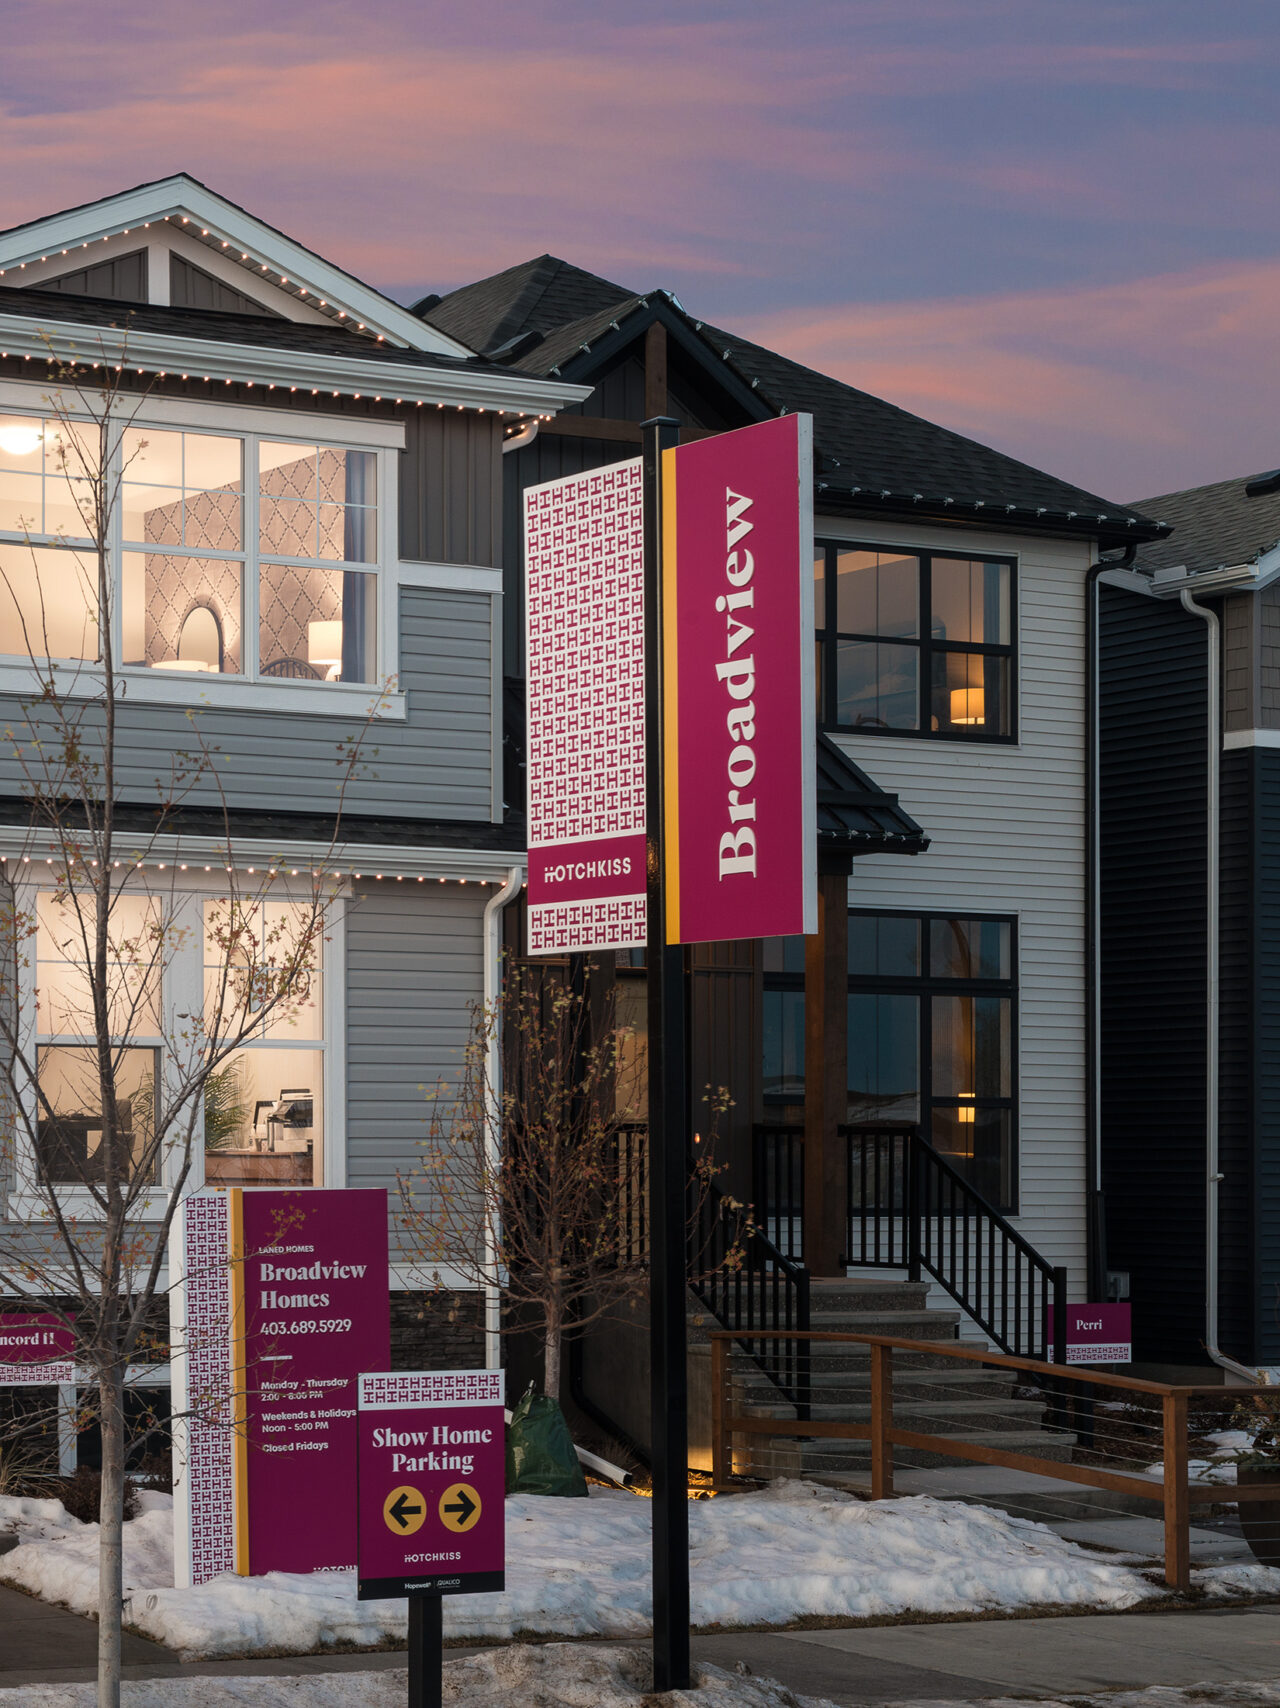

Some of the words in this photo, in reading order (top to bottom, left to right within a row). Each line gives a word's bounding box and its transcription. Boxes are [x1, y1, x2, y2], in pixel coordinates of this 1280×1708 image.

[714, 486, 757, 882] Broadview
[544, 857, 631, 883] HOTCHKISS
[260, 1260, 368, 1282] Broadview
[260, 1290, 330, 1309] Homes
[261, 1319, 352, 1335] 403.689.5929
[1076, 1319, 1103, 1330] Perri
[261, 1381, 299, 1390] Monday
[307, 1378, 348, 1388] Thursday
[261, 1411, 309, 1421] Weekends
[310, 1410, 317, 1419] &
[318, 1409, 357, 1418] Holidays
[262, 1425, 286, 1433] Noon
[294, 1423, 313, 1431] 5:00
[315, 1421, 329, 1430] PM
[372, 1427, 428, 1448] Show
[432, 1426, 493, 1445] Home
[262, 1443, 294, 1453] Closed
[295, 1442, 329, 1451] Fridays
[392, 1451, 474, 1475] Parking
[404, 1552, 461, 1563] HOTCHKISS
